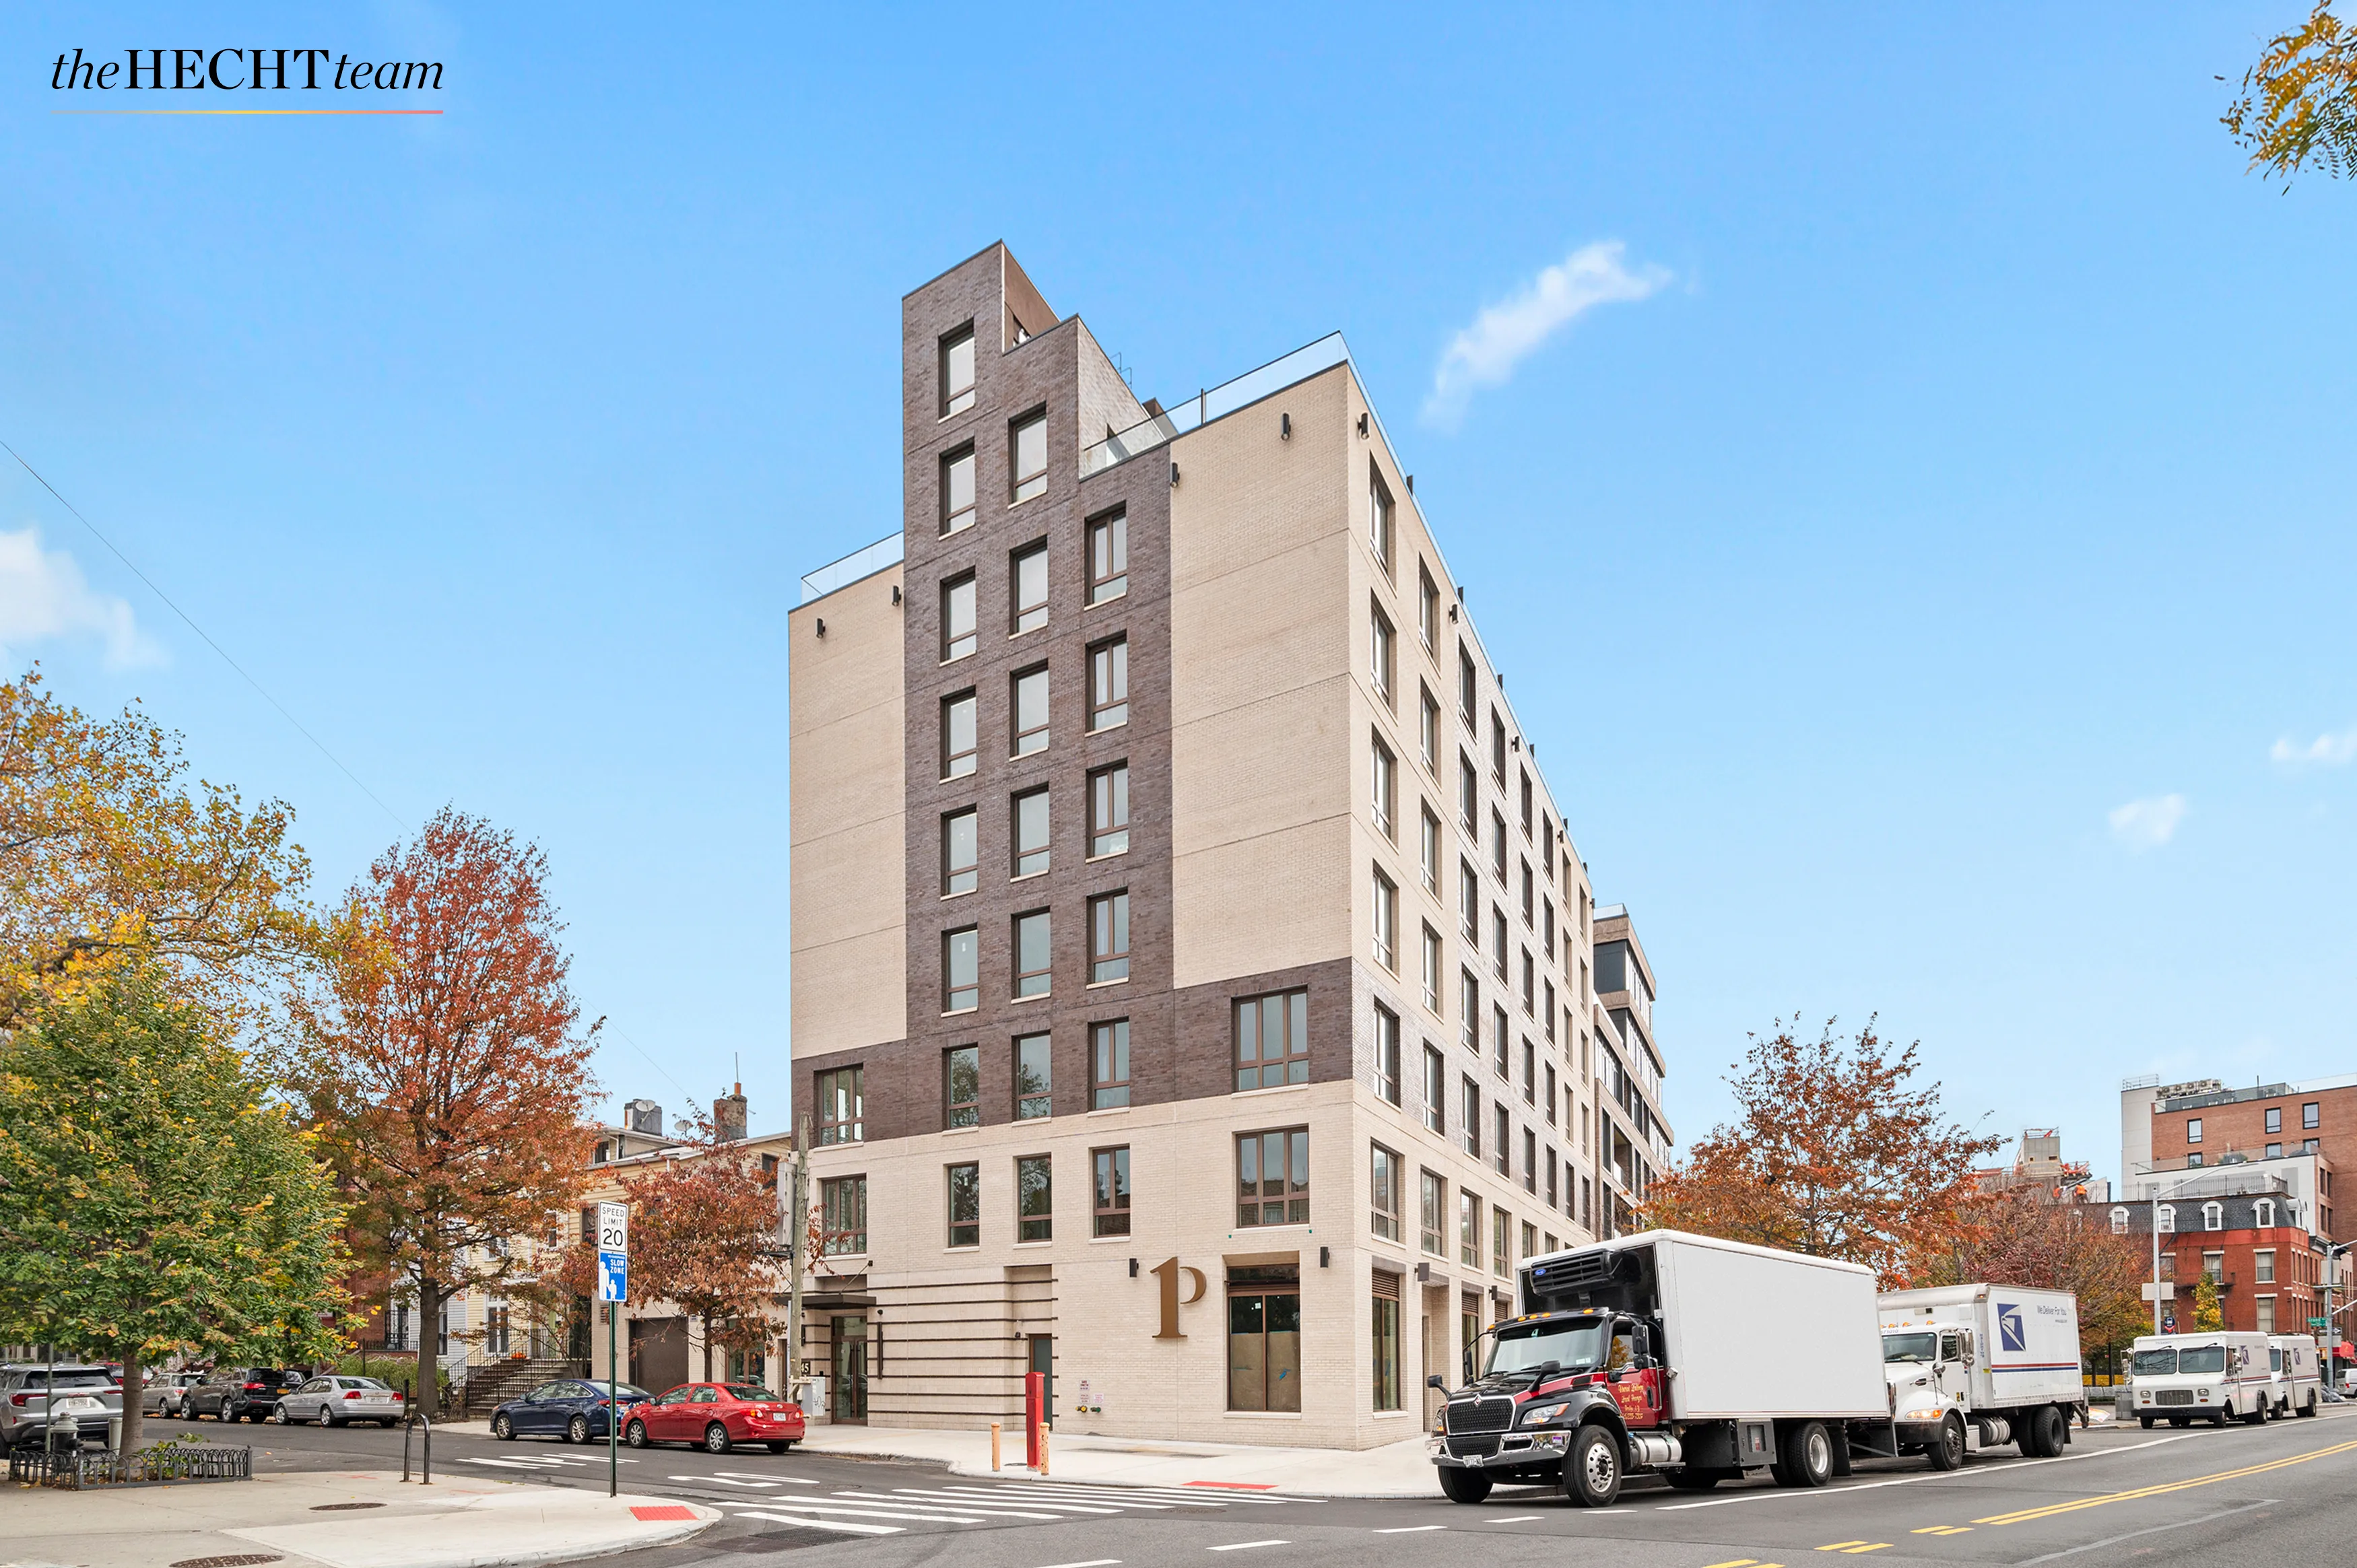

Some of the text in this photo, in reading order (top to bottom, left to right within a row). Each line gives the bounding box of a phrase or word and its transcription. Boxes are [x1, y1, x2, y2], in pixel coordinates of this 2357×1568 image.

[602, 1206, 624, 1217] SPEED
[603, 1217, 622, 1226] LIMIT
[603, 1228, 623, 1246] 20
[610, 1259, 624, 1267] SLOW
[610, 1266, 624, 1274] ZONE
[455, 1453, 640, 1470] MPH
[667, 1472, 820, 1488] 20
